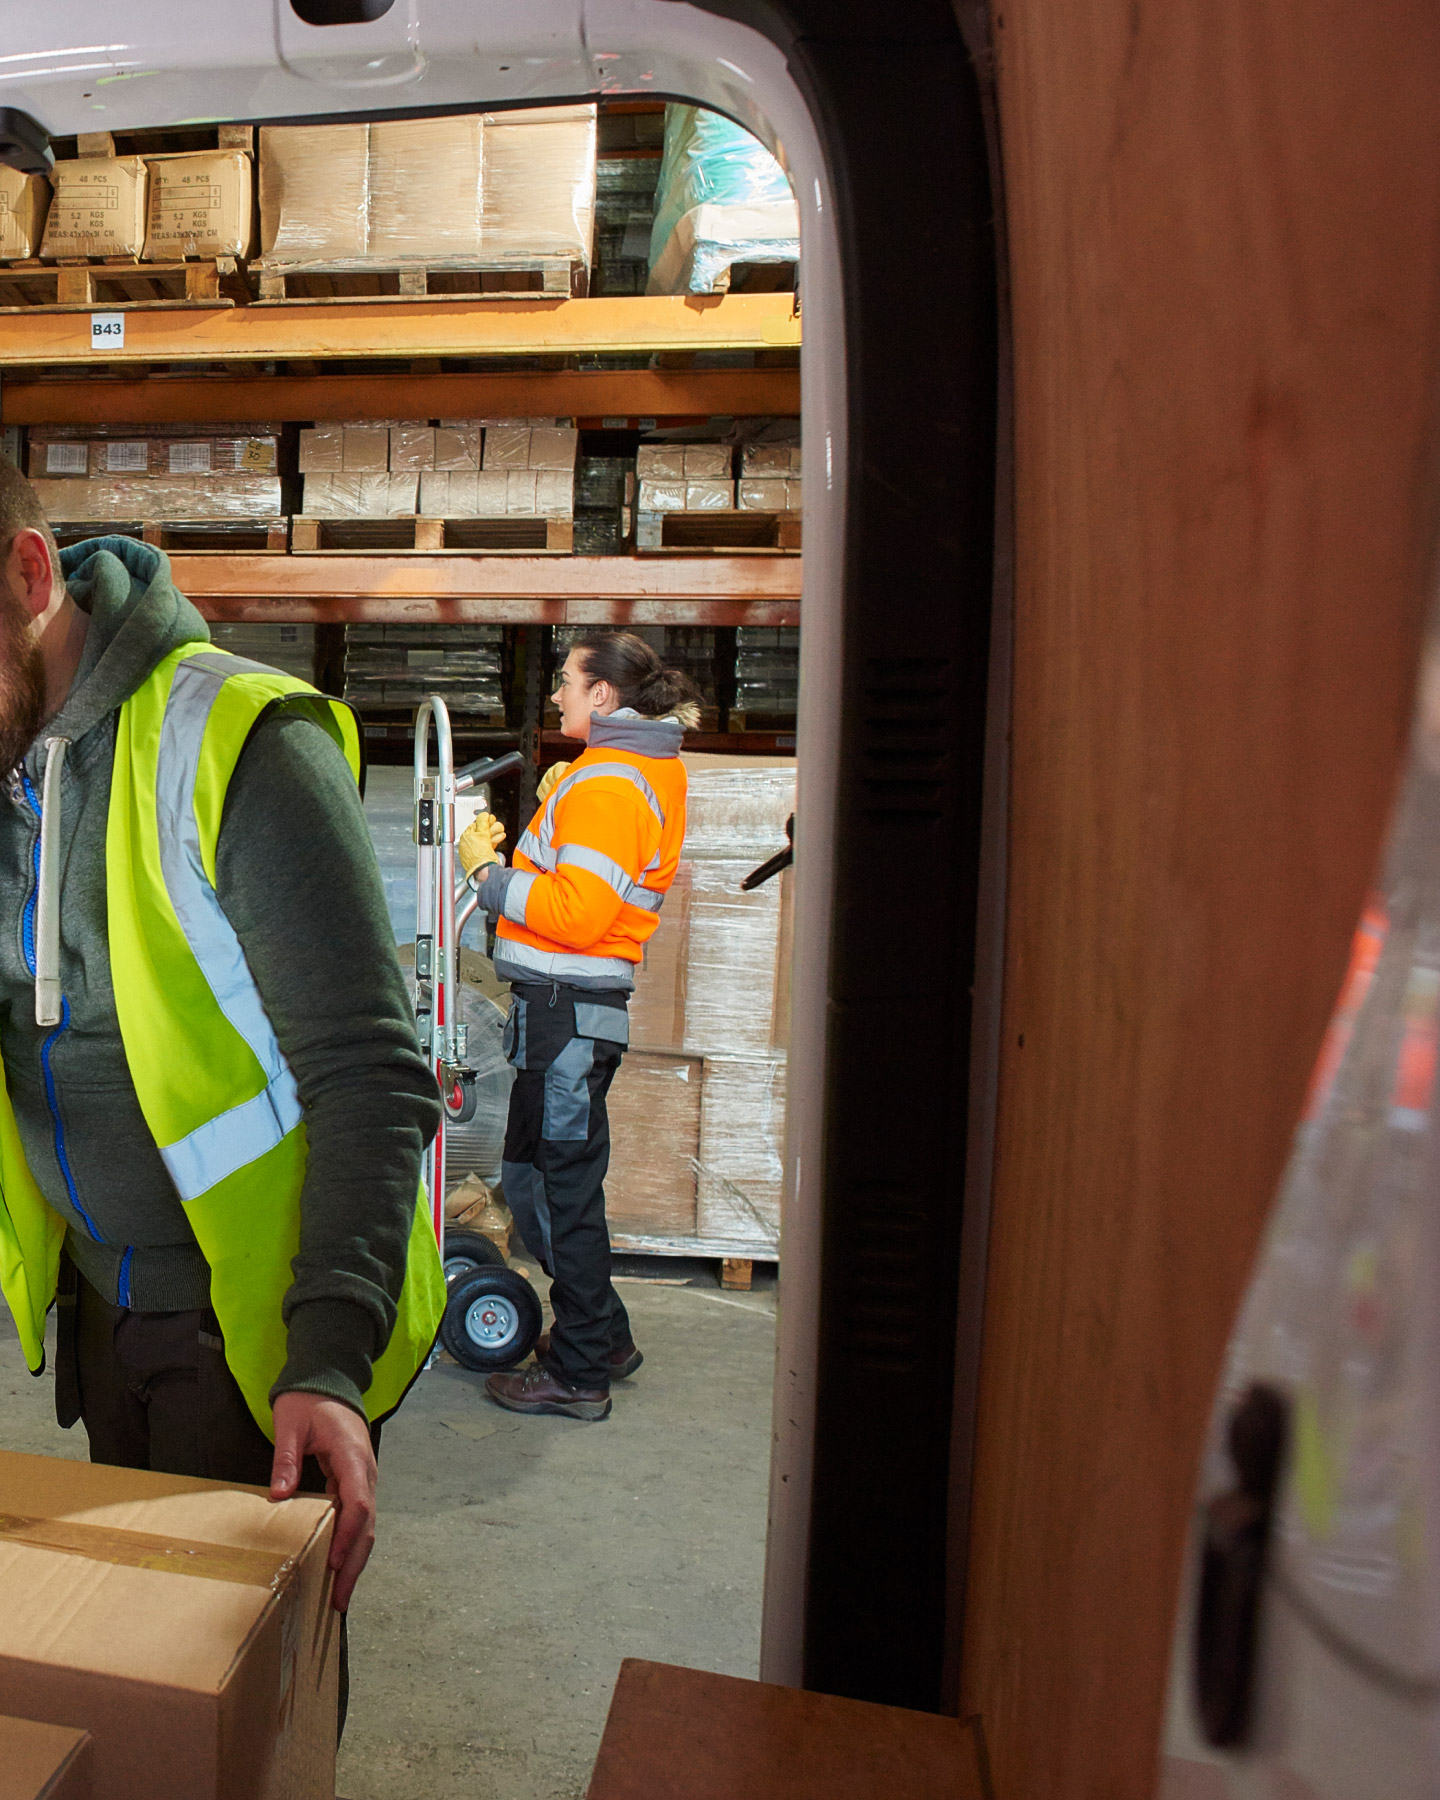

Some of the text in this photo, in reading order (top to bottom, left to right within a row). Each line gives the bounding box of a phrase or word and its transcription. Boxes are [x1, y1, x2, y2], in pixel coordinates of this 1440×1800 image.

[79, 175, 88, 183] 48
[93, 175, 107, 183] PCS
[195, 175, 210, 183] PCS
[70, 212, 81, 220] 5.2
[90, 220, 104, 228] KGS
[192, 220, 207, 228] KGS
[207, 229, 218, 237] CM
[92, 323, 122, 336] B43
